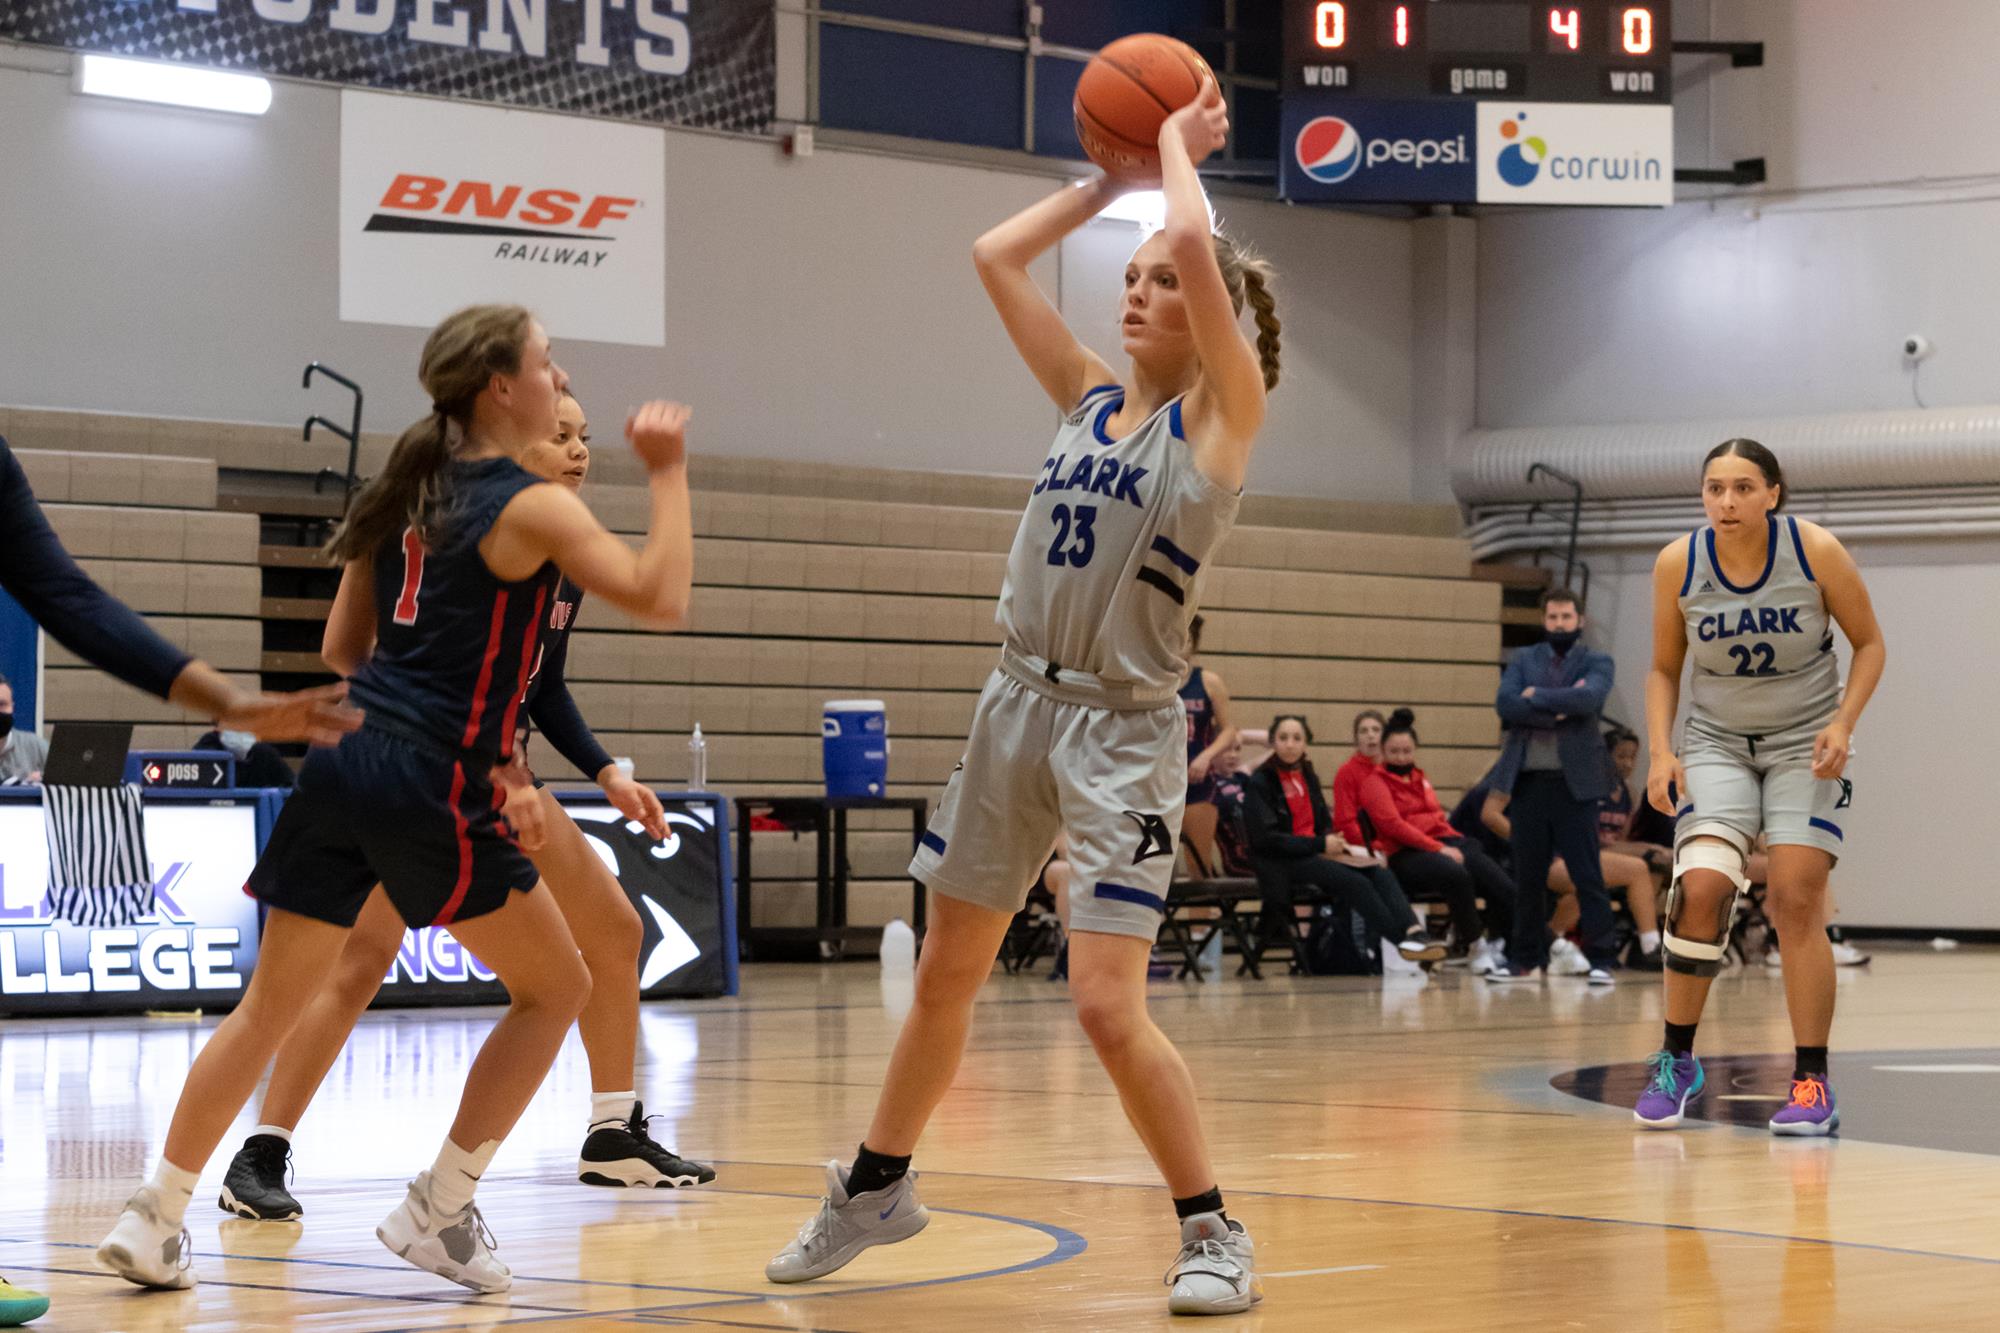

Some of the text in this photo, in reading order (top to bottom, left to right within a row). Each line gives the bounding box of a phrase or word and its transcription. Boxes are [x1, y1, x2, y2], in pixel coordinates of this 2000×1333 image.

[1316, 1, 1345, 47] 0
[1394, 6, 1409, 47] 1
[1549, 9, 1579, 50] 4
[1622, 8, 1653, 54] 0
[1303, 65, 1348, 86] won
[1450, 68, 1507, 94] game
[1610, 71, 1654, 92] won
[1366, 135, 1466, 168] pepsi
[1550, 151, 1661, 181] corwin
[380, 173, 638, 229] BNSF
[495, 242, 608, 267] RAILWAY
[1033, 453, 1149, 509] CLARK
[1047, 503, 1097, 568] 23
[393, 526, 426, 626] 1
[1697, 607, 1804, 642] CLARK
[1728, 642, 1777, 677] 22
[167, 763, 199, 785] poss
